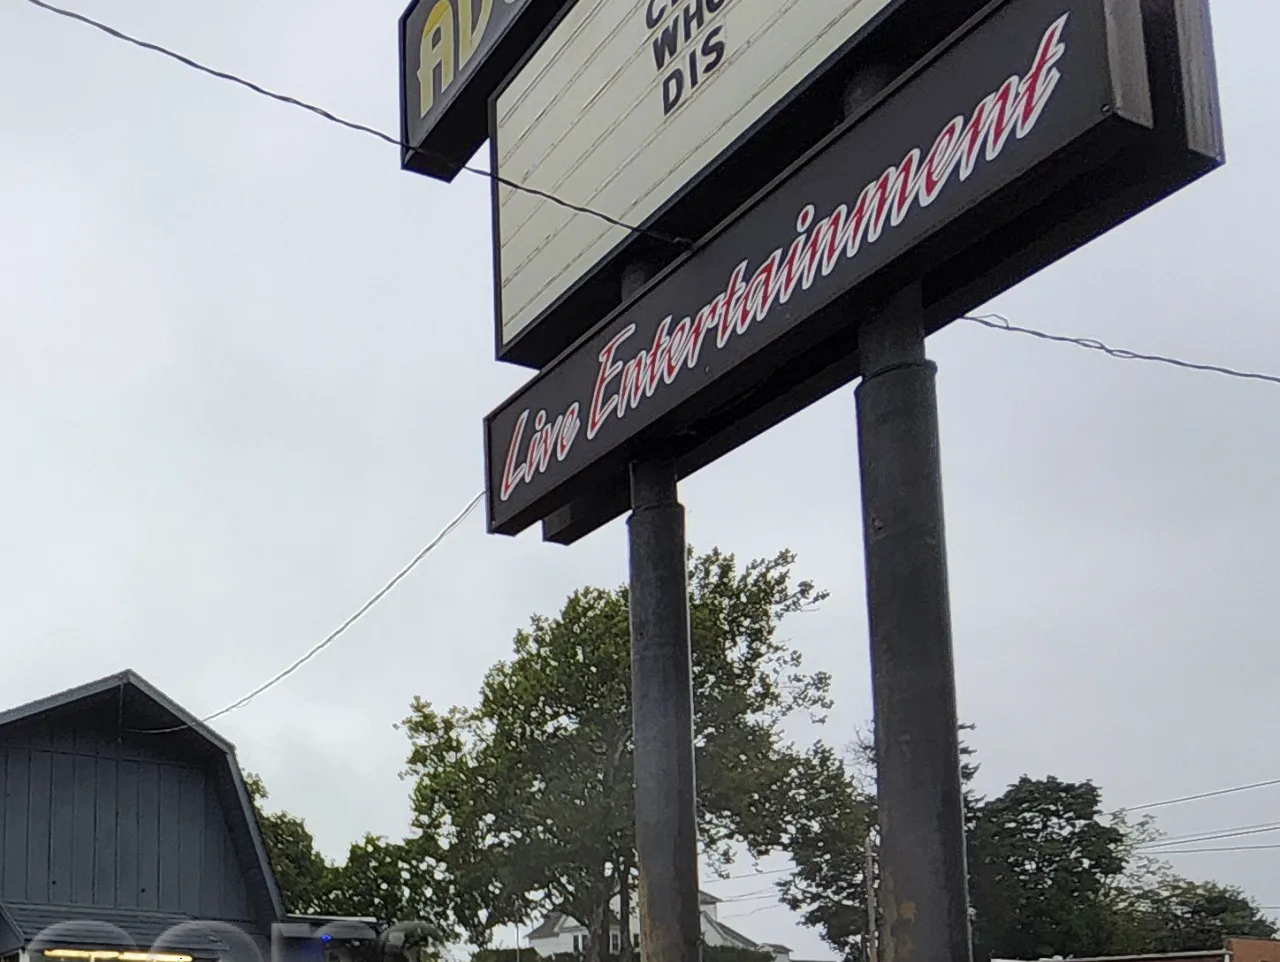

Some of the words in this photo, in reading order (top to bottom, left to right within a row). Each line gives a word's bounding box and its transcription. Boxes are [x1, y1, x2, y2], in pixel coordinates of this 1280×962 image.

[653, 0, 724, 72] WH
[662, 24, 725, 116] DIS
[501, 402, 580, 501] Live
[587, 11, 1070, 440] Entertainment
